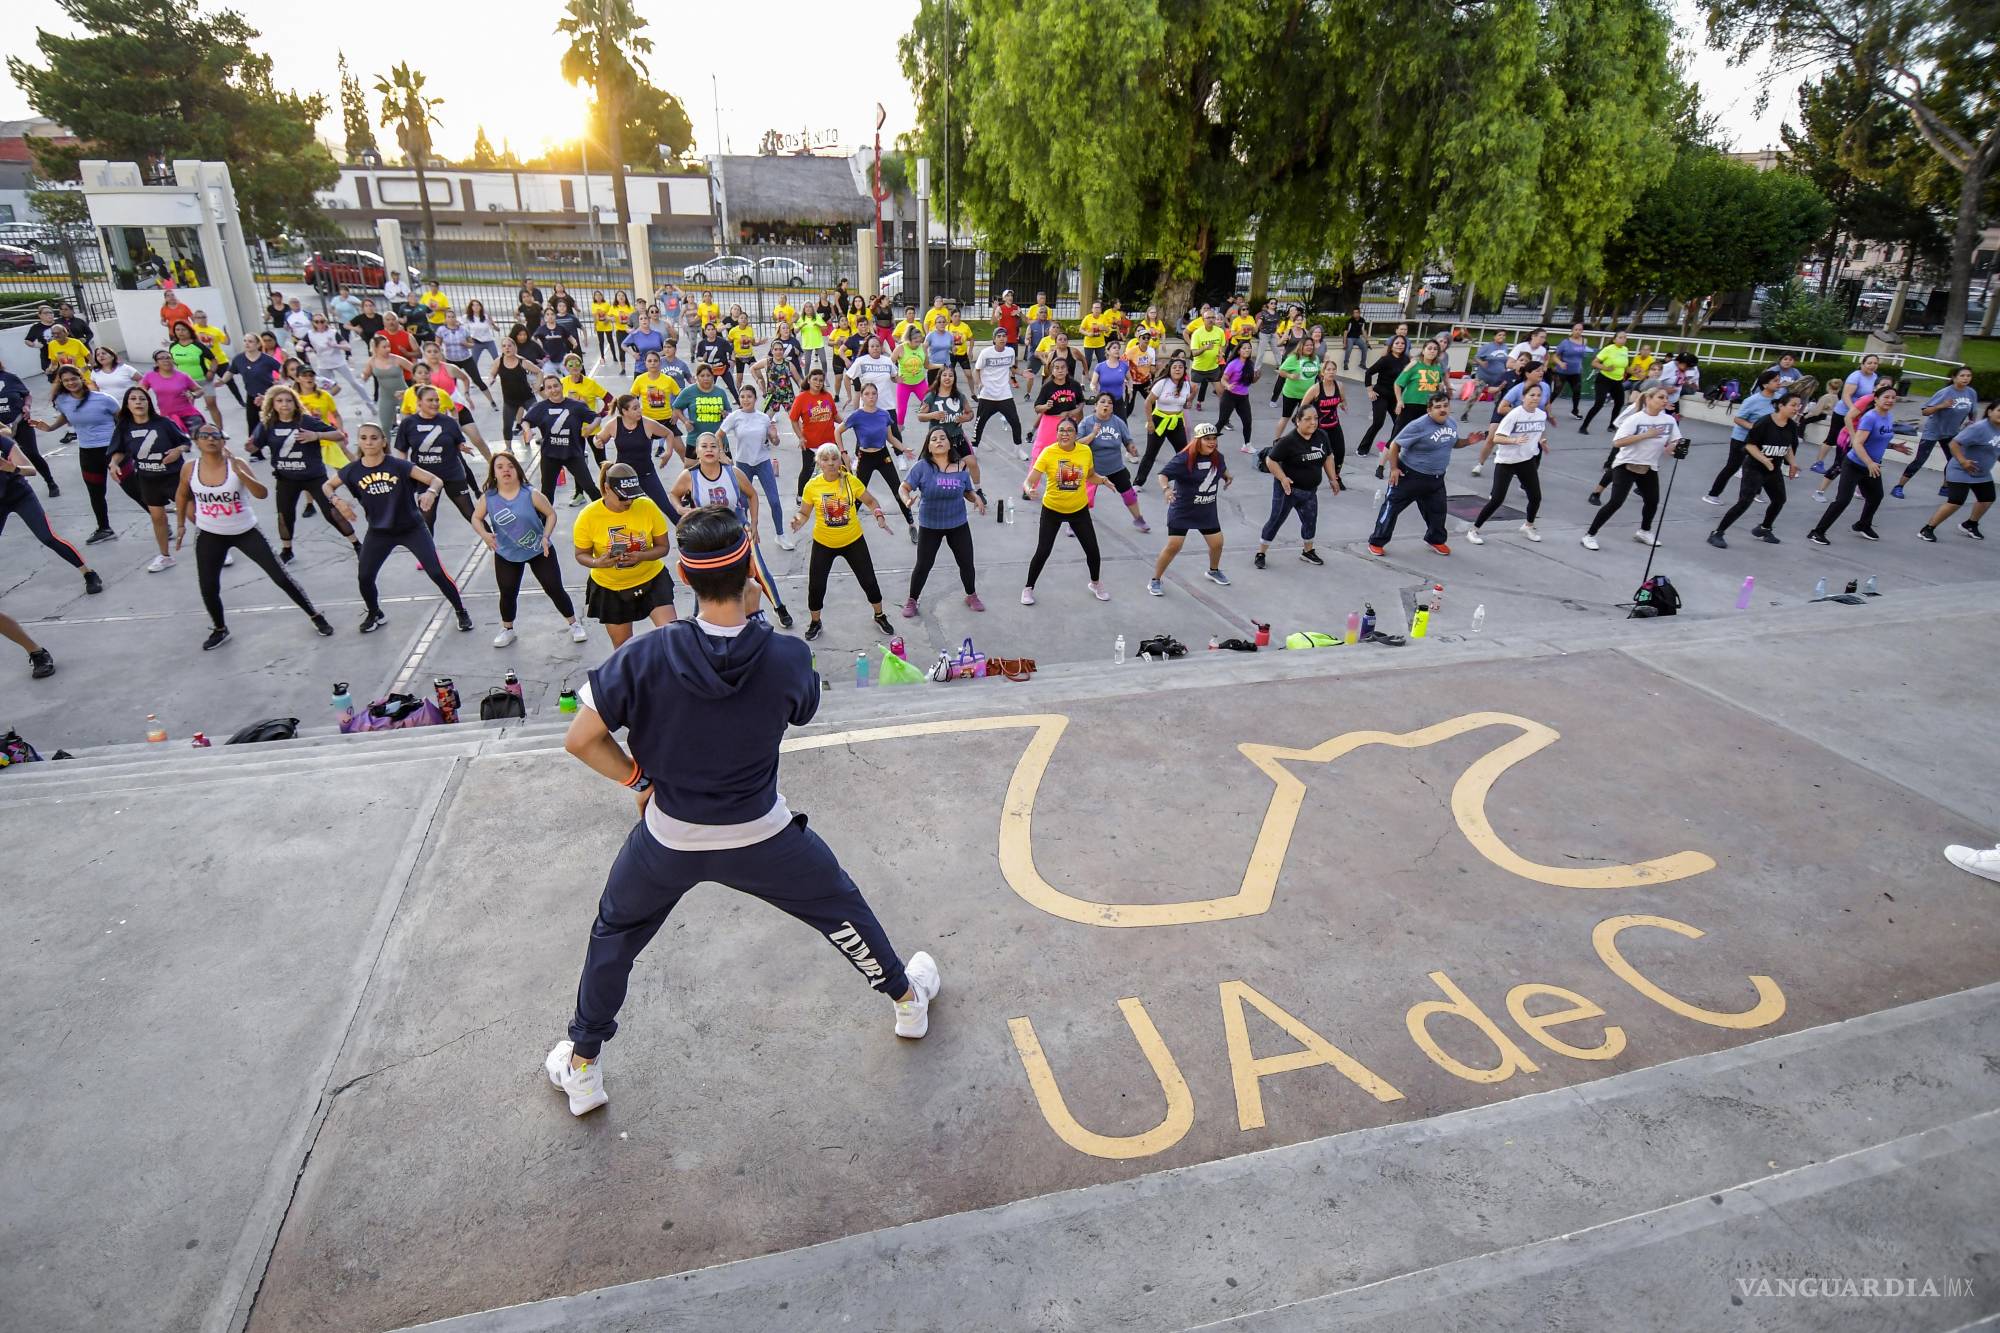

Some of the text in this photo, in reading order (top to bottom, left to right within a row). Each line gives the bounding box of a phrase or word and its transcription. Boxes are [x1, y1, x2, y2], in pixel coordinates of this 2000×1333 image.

[660, 365, 683, 375] ZUMBA
[864, 364, 891, 373] ZUMBA
[1051, 389, 1076, 400] ZUMBA
[548, 408, 570, 436] Z
[416, 424, 442, 453] Z
[1430, 427, 1457, 442] ZUMBA
[130, 429, 163, 460] Z
[274, 428, 303, 458] Z
[138, 461, 166, 470] ZUMBA
[276, 461, 306, 470] ZUMBA
[358, 472, 399, 490] ZUMBA
[829, 921, 888, 988] ZUMBA
